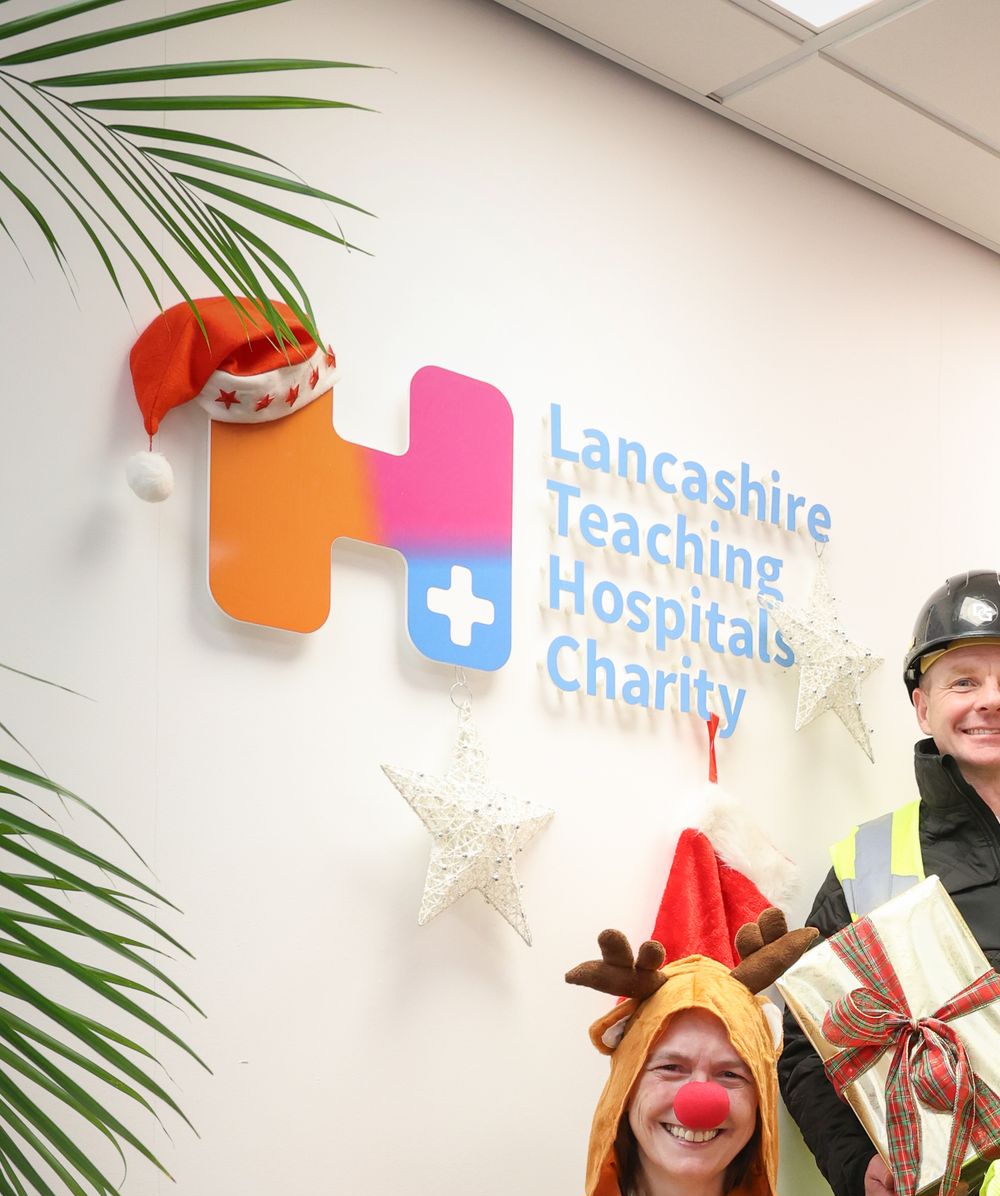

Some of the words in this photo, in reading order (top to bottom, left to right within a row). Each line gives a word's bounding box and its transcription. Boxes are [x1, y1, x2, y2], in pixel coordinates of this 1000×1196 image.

[550, 402, 832, 543] Lancashire
[546, 479, 784, 609] Teaching
[549, 554, 796, 668] Hospitals
[547, 635, 747, 739] Charity
